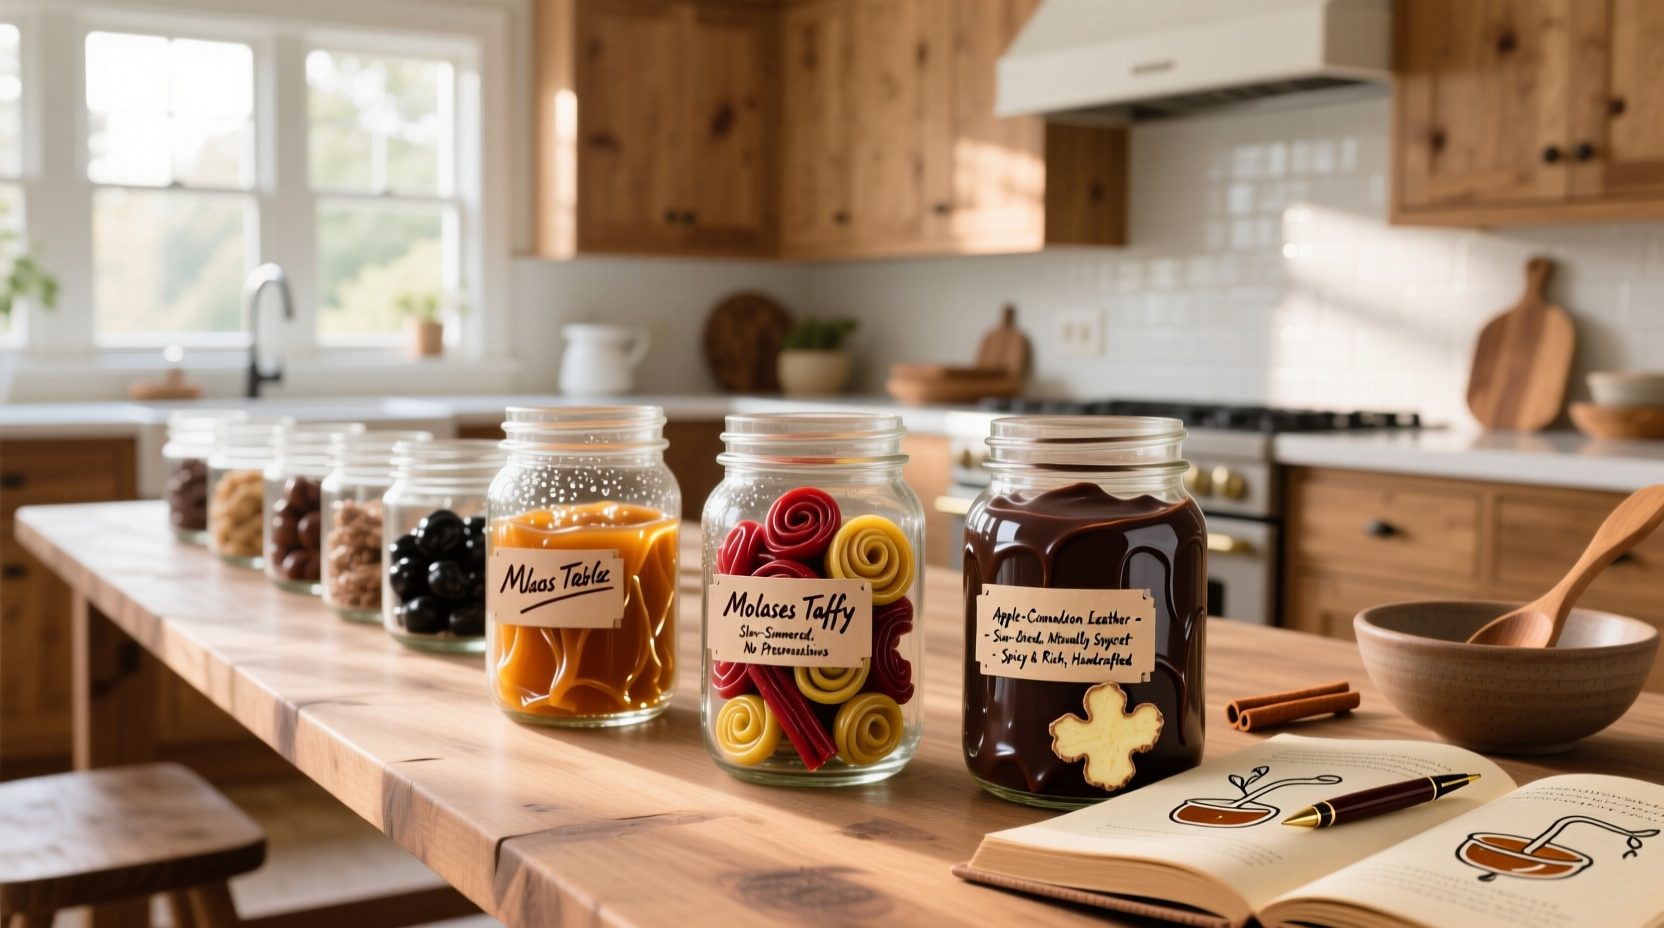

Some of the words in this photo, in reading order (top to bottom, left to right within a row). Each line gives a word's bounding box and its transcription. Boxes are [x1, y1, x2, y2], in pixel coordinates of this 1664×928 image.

[722, 590, 796, 620] Molases
[802, 592, 856, 634] Taffy
[1001, 648, 1028, 670] Spicy
